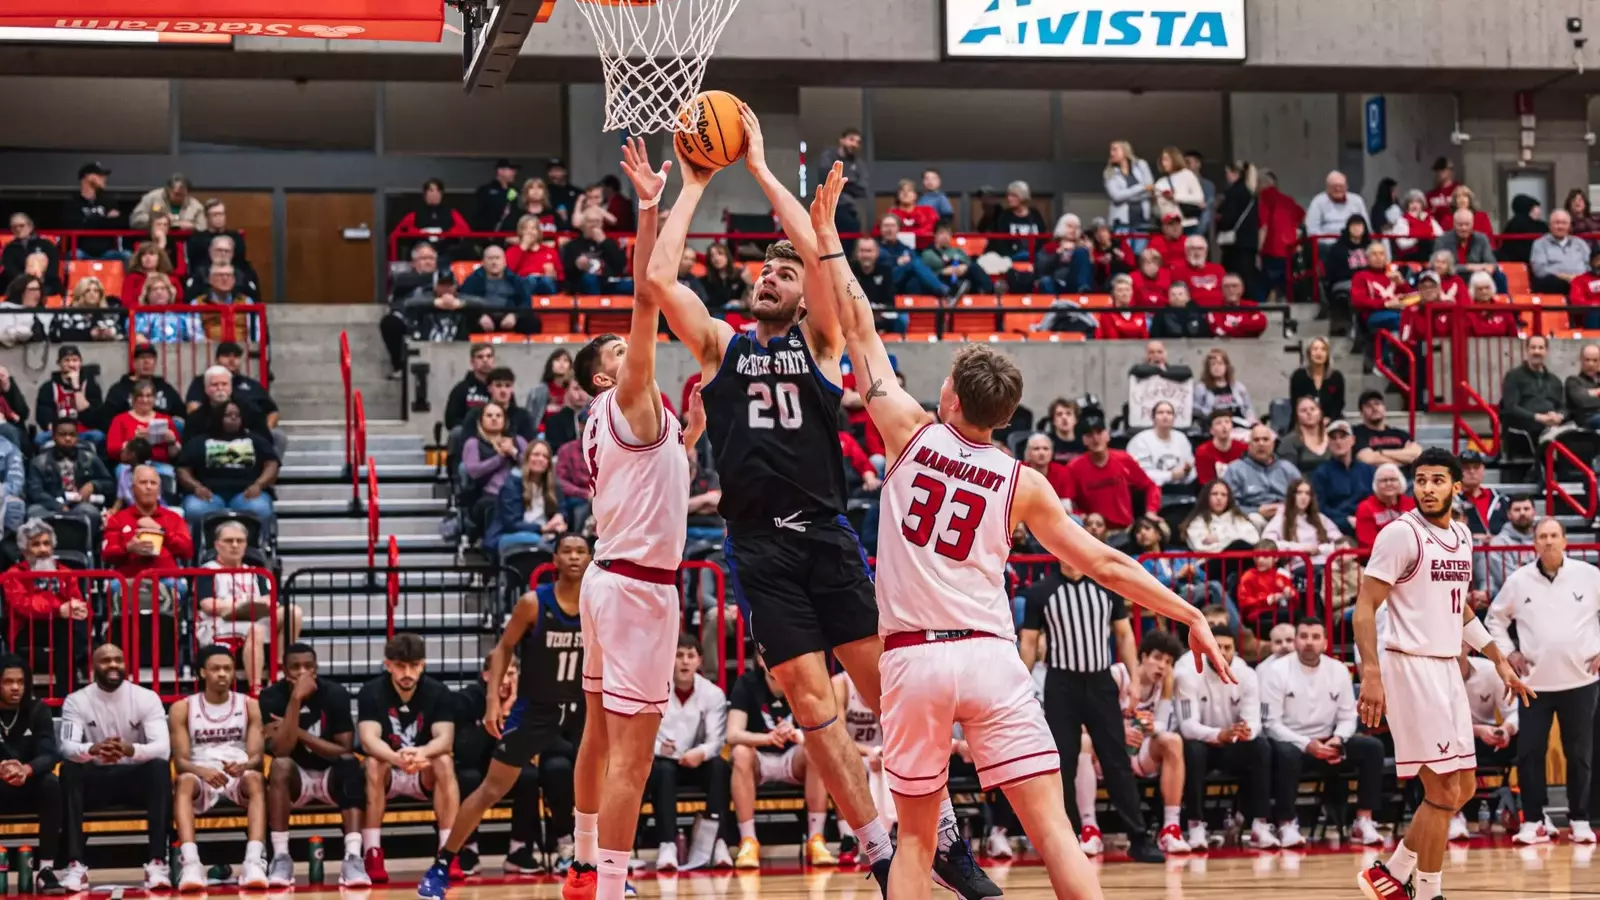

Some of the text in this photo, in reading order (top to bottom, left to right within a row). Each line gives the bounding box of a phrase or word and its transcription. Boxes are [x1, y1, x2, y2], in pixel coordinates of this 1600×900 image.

[958, 0, 1229, 48] AVISTA
[735, 350, 810, 377] WEBER STATE
[747, 382, 804, 430] 20
[913, 445, 1007, 494] MARQUARDT
[901, 472, 988, 563] 33
[556, 651, 579, 682] 11
[854, 727, 877, 742] 20
